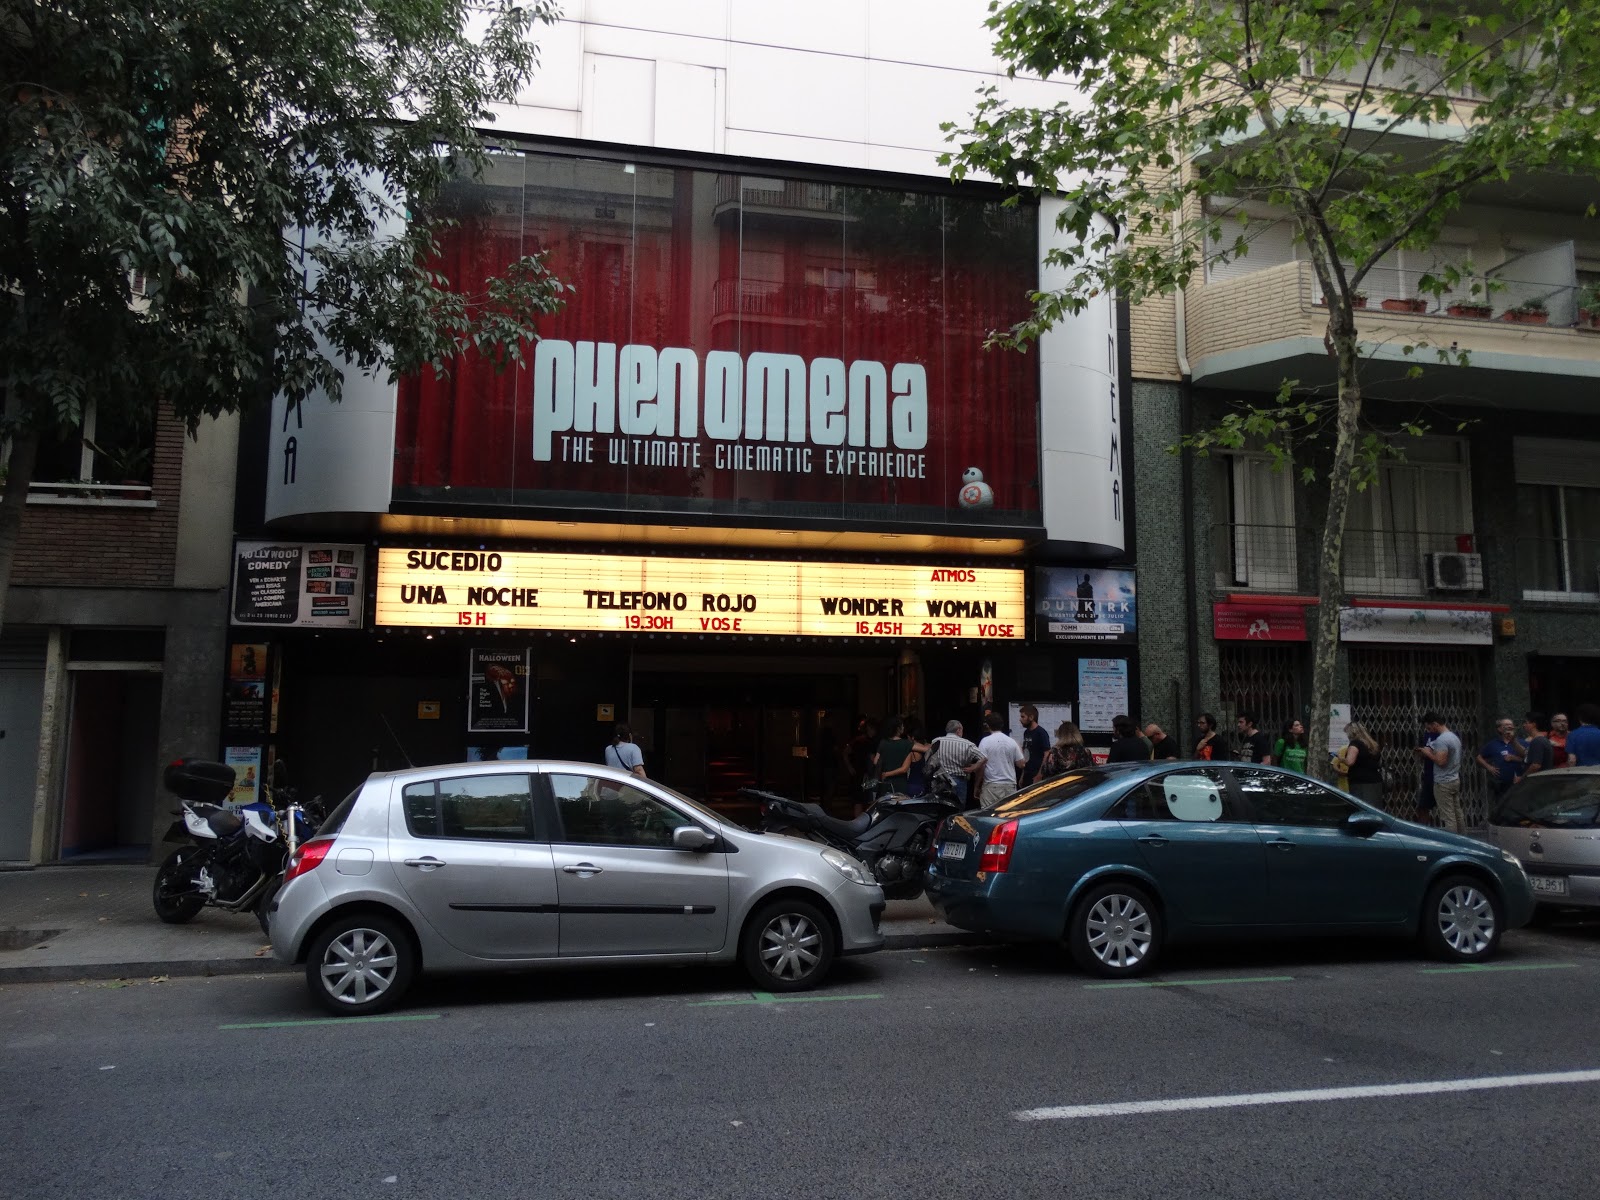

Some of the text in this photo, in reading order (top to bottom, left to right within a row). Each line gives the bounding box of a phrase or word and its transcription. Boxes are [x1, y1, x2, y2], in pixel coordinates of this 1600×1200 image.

[561, 436, 927, 479] THE ULTIMATE CINEMATIC EXPERIENCE
[241, 549, 299, 560] HOLLYWOOD
[406, 550, 502, 573] SUCEDIO
[247, 561, 291, 571] COMEDY
[930, 568, 976, 584] ATMOS
[400, 585, 538, 608] UNA NOCHE
[583, 590, 757, 613] TELEFONO ROJO
[820, 597, 997, 619] WONDER WOMAN
[1042, 601, 1129, 612] DUNKIRK
[625, 615, 742, 632] 19.30H VOSE
[855, 621, 903, 636] 16.45H
[978, 624, 1015, 638] VOSE
[479, 654, 521, 662] HALLOWEEN
